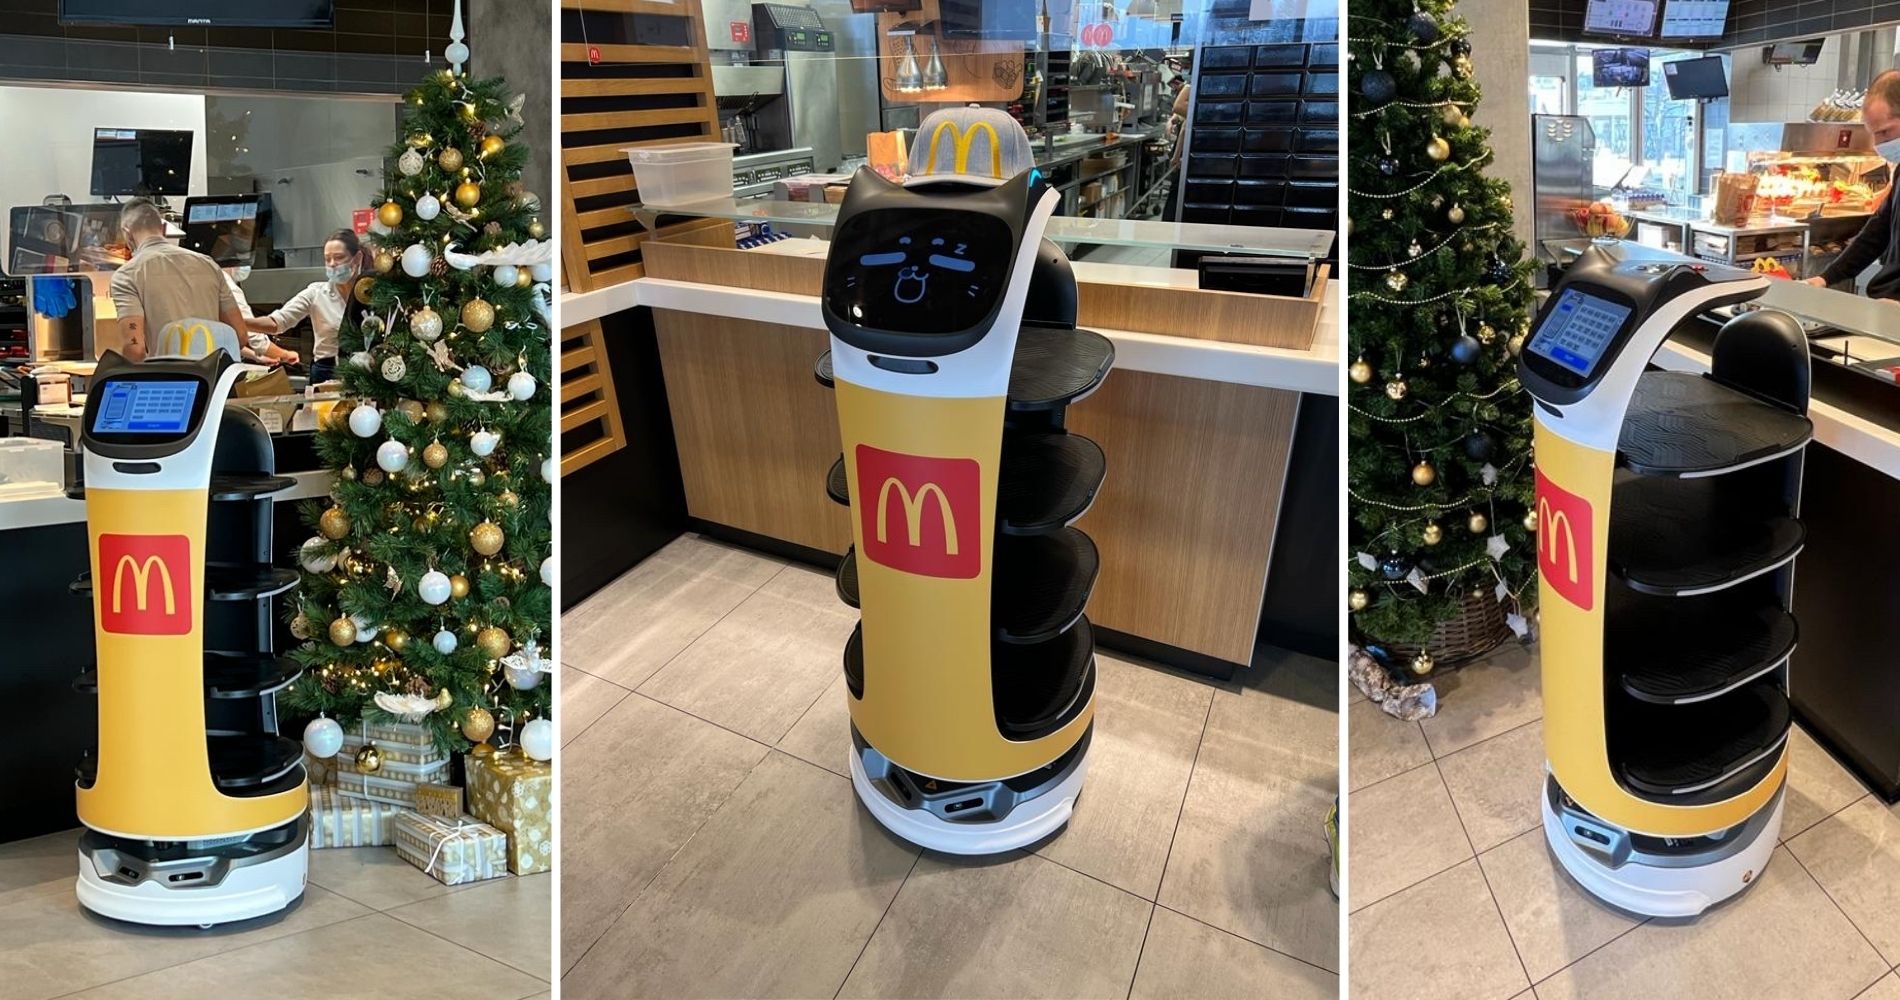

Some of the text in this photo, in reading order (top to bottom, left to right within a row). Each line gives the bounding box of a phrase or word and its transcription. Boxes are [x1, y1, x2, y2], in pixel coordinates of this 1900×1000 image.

[926, 121, 1002, 179] M
[877, 477, 959, 555] M
[1539, 496, 1578, 585] M
[113, 554, 175, 615] M
